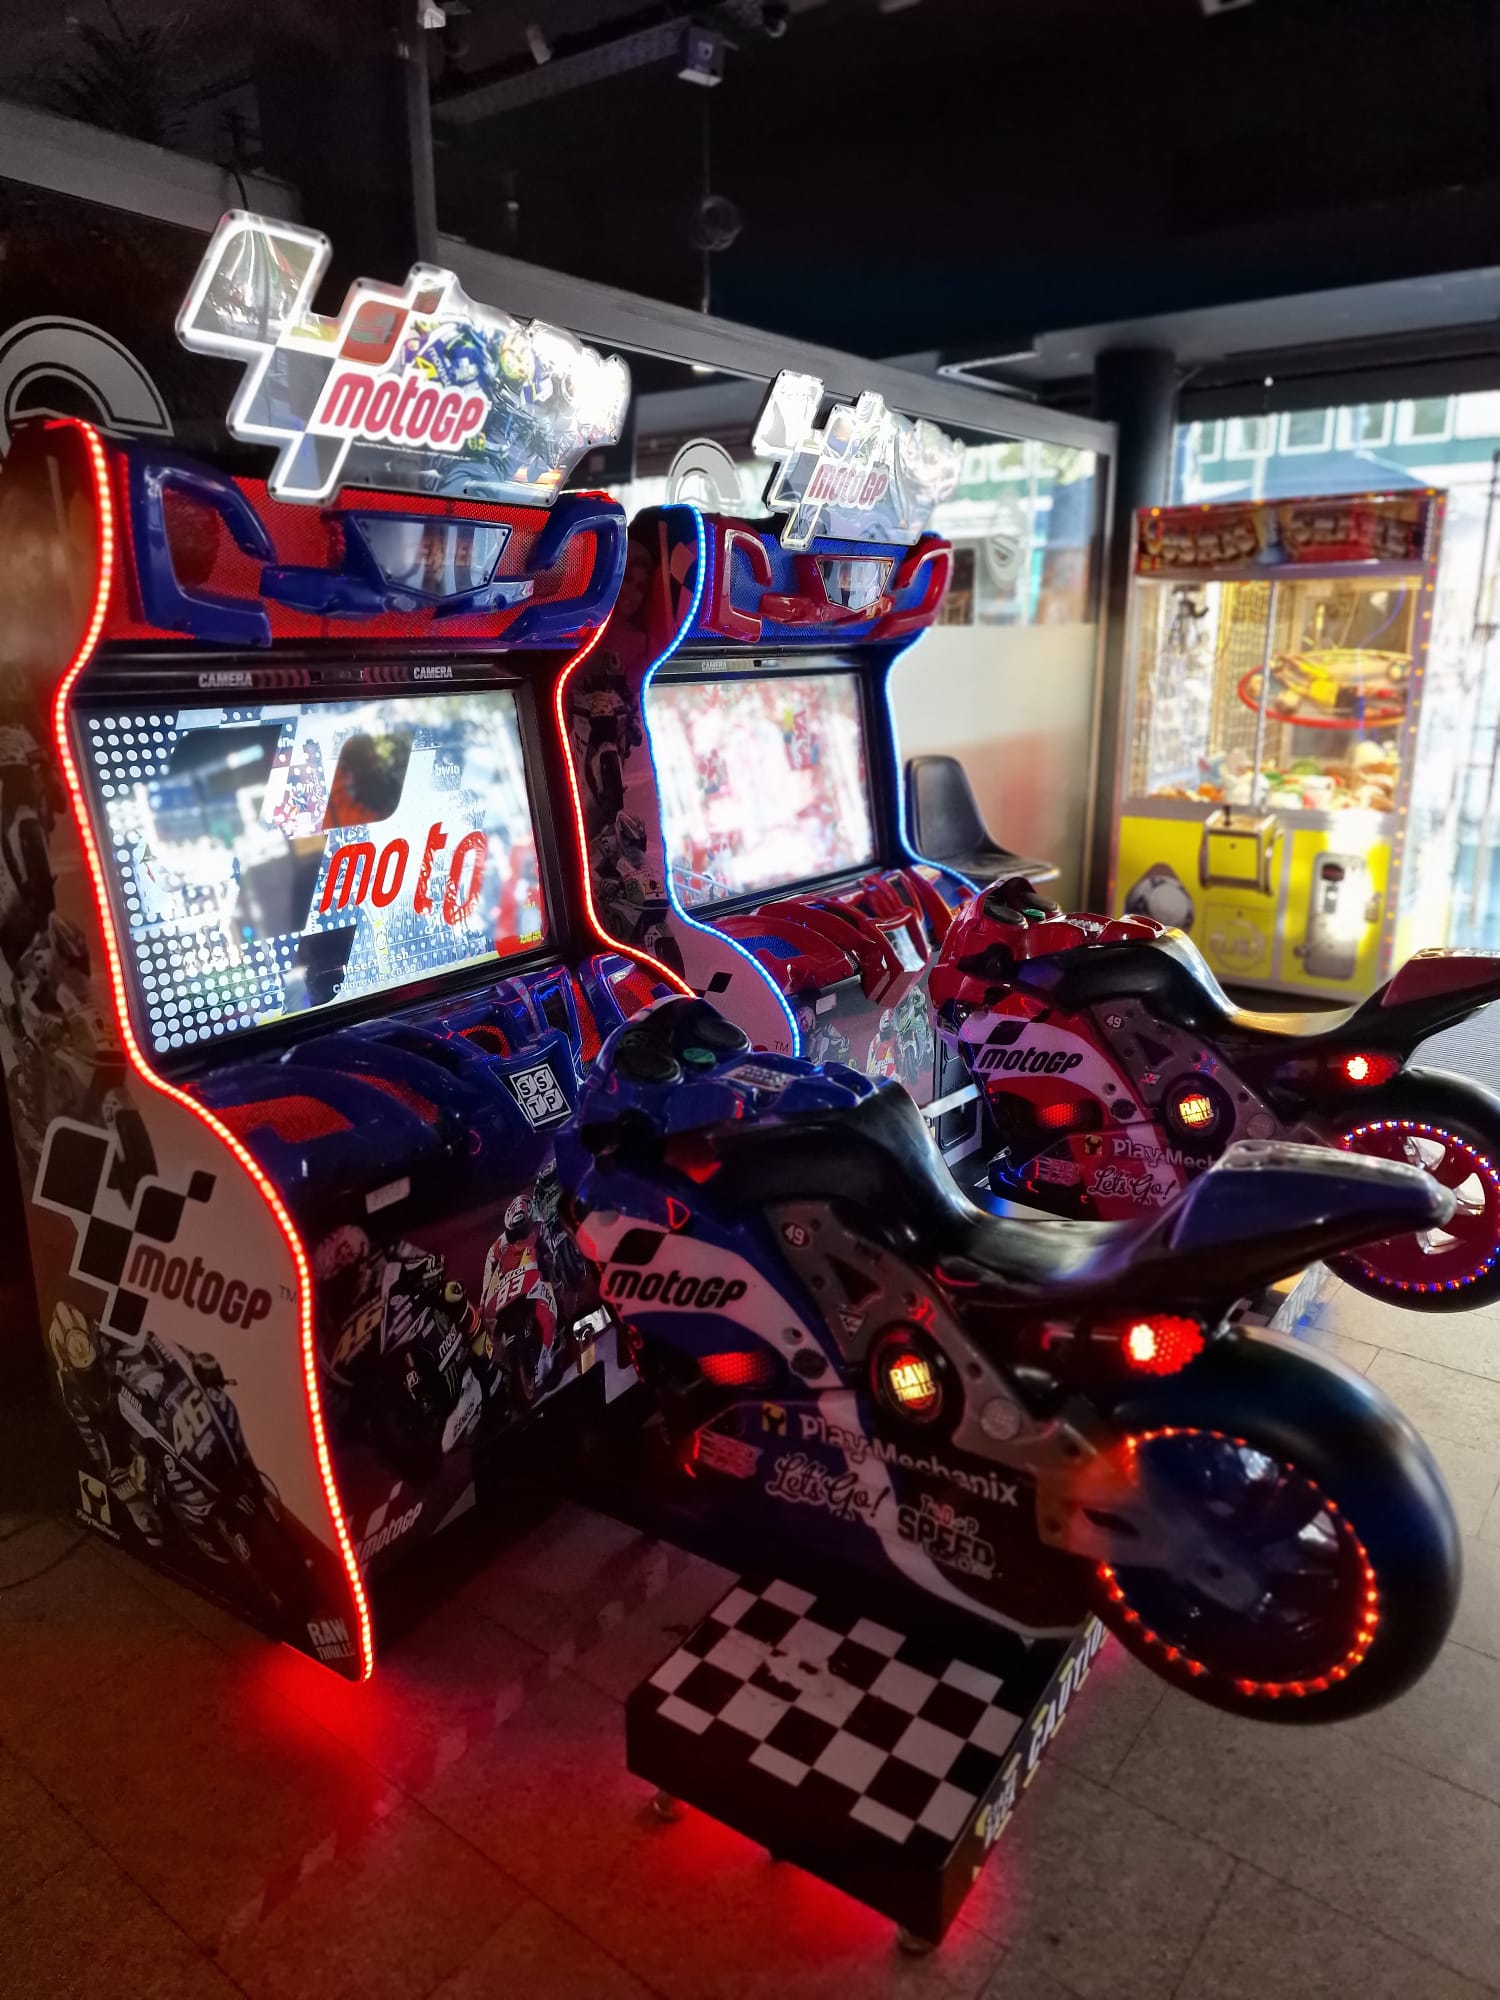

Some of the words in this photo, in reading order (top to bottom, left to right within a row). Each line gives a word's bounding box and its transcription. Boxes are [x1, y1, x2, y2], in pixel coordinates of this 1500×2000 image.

[413, 666, 453, 679] CAMERA
[701, 661, 727, 671] CAMERA
[198, 672, 253, 688] CAMERA
[342, 959, 377, 976] Insert
[381, 951, 409, 965] Cash
[1106, 1016, 1122, 1029] 49
[1179, 1097, 1210, 1116] RAW
[1130, 1173, 1176, 1204] Go!
[785, 1224, 805, 1245] 49
[890, 1361, 930, 1390] RAW
[306, 1616, 350, 1646] RAW
